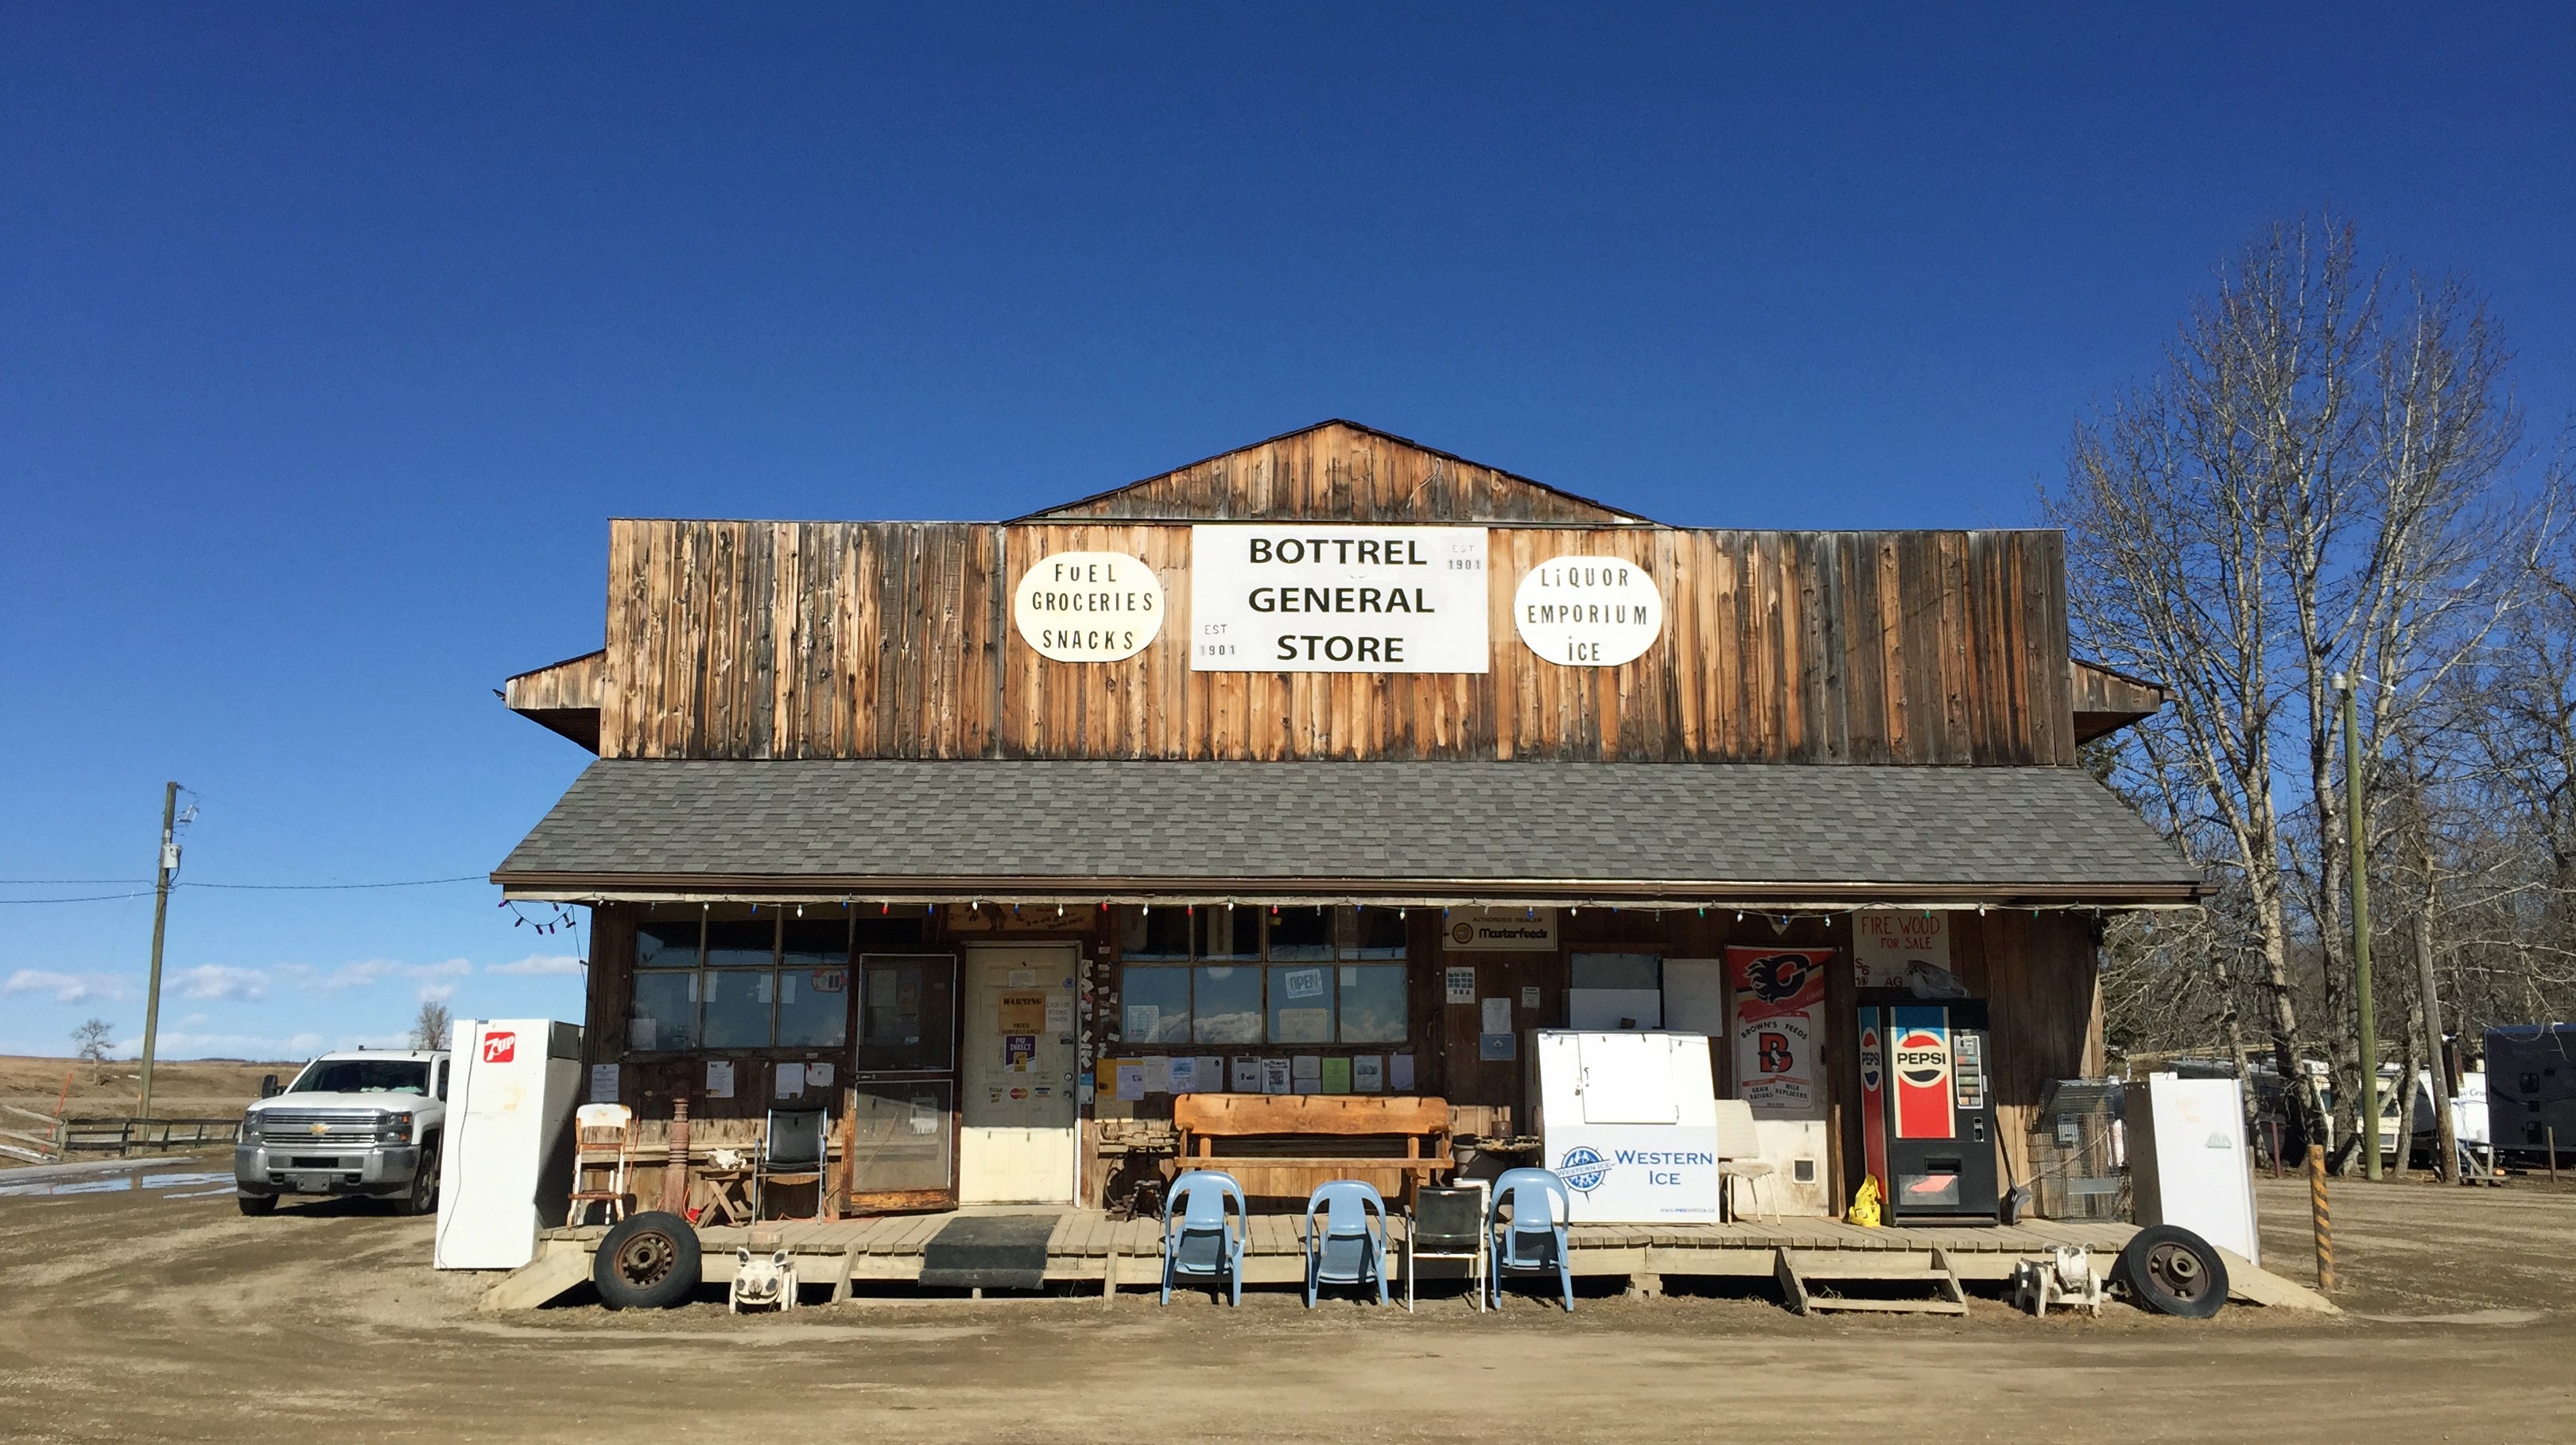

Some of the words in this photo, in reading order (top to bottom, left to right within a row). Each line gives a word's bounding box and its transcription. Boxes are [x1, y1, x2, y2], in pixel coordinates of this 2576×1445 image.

[1250, 539, 1428, 565] BOTTREL
[1452, 544, 1476, 553] EST
[1448, 559, 1481, 570] 1901
[1032, 591, 1153, 612] GROCERIES
[1248, 587, 1435, 612] GENERAL
[1527, 604, 1647, 625] EMPORIUM
[1205, 623, 1228, 635] EST
[1043, 629, 1134, 650] SNACKS
[1199, 644, 1236, 656] 1901
[1277, 635, 1404, 663] STORE
[1480, 926, 1548, 938] Masterfeeds
[1861, 916, 1892, 935] FIRE
[1898, 915, 1941, 934] WOOD
[1880, 938, 1899, 950] FOR
[1905, 937, 1932, 950] SALE
[1289, 973, 1321, 990] OPEN
[1740, 1021, 1779, 1039] BROWN'S
[1784, 1024, 1809, 1040] FEEDS
[1861, 1051, 1880, 1066] PEPSI
[1897, 1052, 1946, 1065] PEPSI
